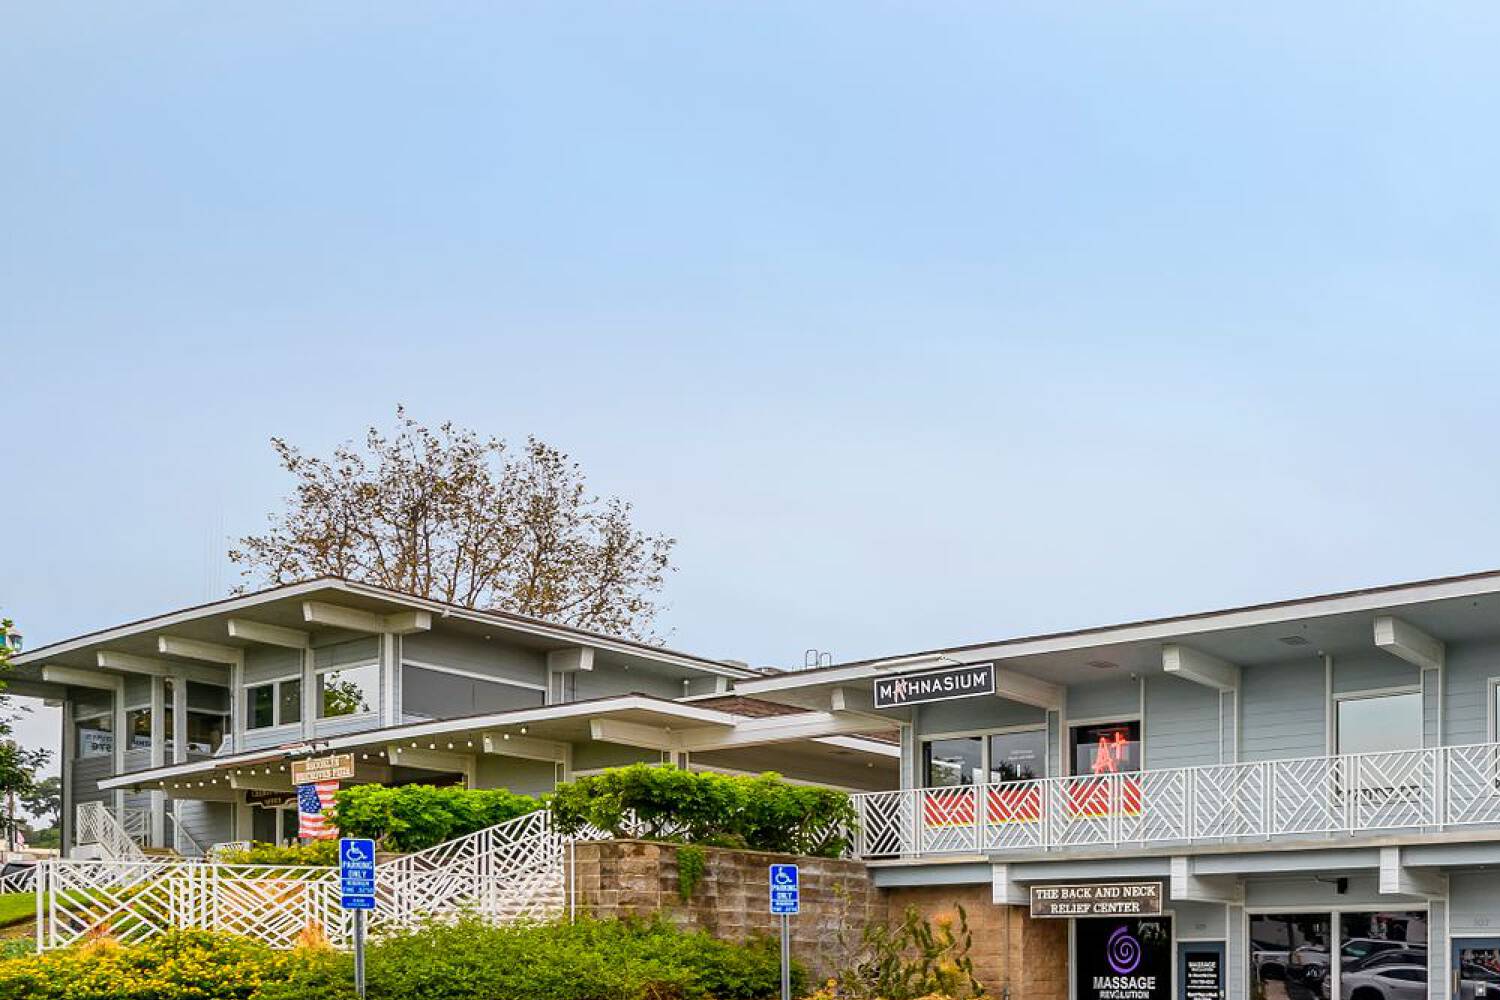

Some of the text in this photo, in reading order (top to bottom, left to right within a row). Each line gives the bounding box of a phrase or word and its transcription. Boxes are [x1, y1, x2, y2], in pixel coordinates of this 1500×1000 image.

[1035, 885, 1156, 900] THE BACK AND NECK
[1050, 901, 1141, 914] RELIEF CENTER
[1092, 976, 1156, 990] MASSAGE
[1099, 989, 1150, 1000] REVOLUTION
